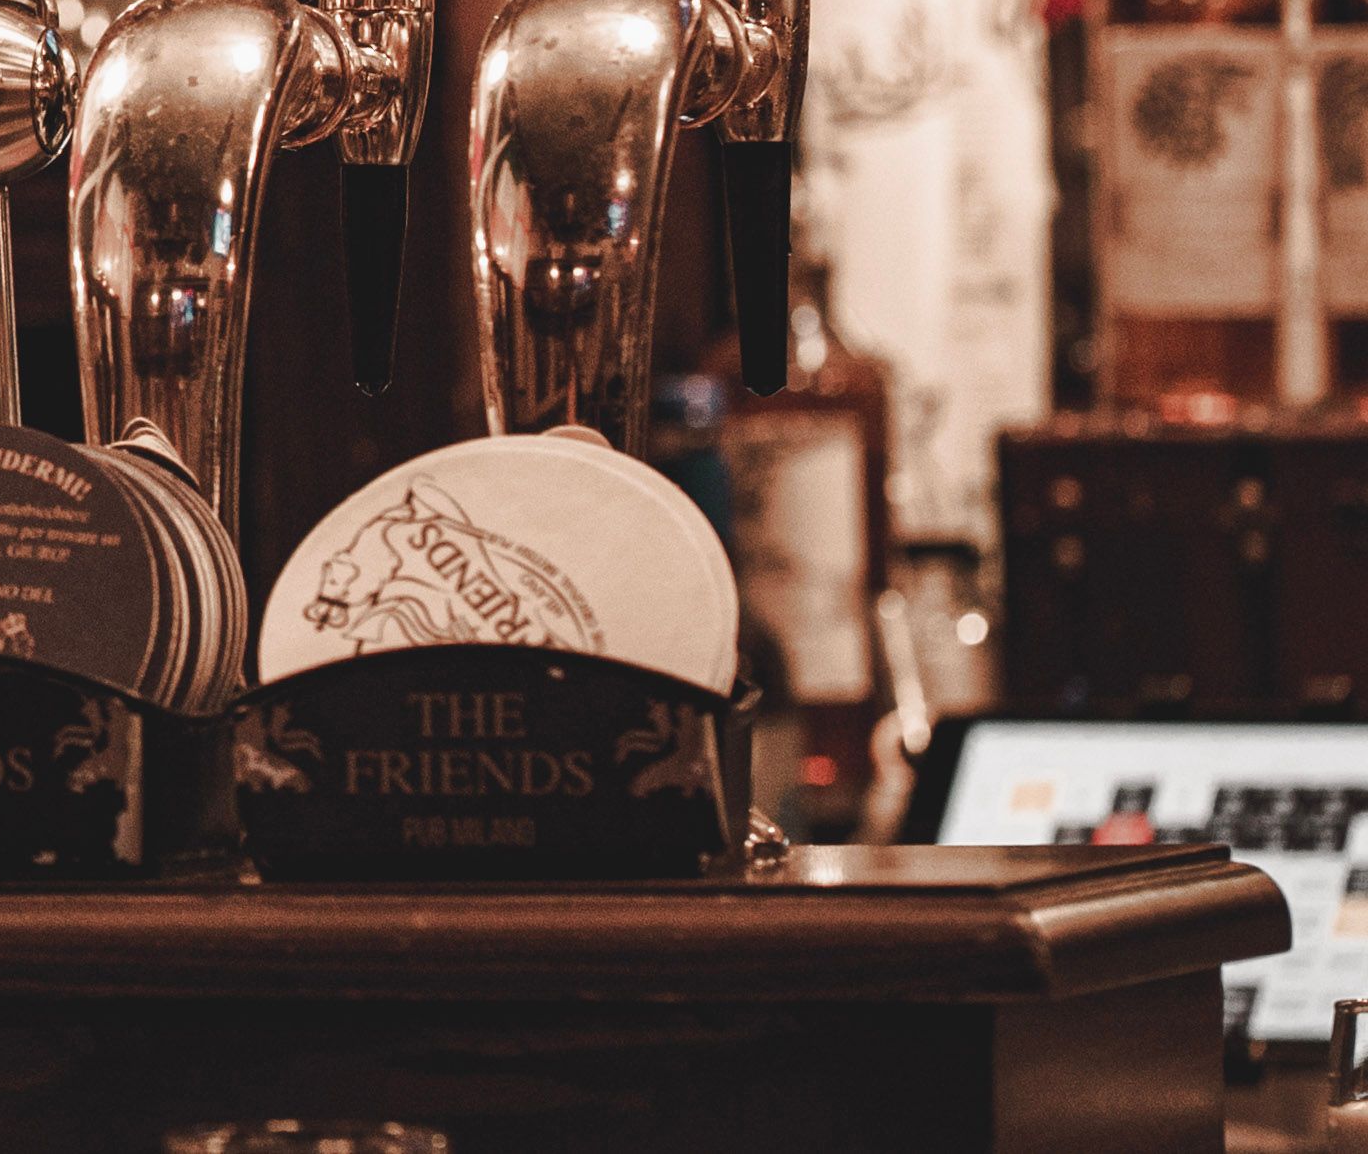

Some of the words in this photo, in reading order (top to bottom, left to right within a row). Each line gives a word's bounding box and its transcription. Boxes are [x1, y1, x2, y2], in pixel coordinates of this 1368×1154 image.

[409, 521, 538, 645] RIENDS
[406, 690, 528, 740] THE
[343, 749, 595, 799] FRIENDS
